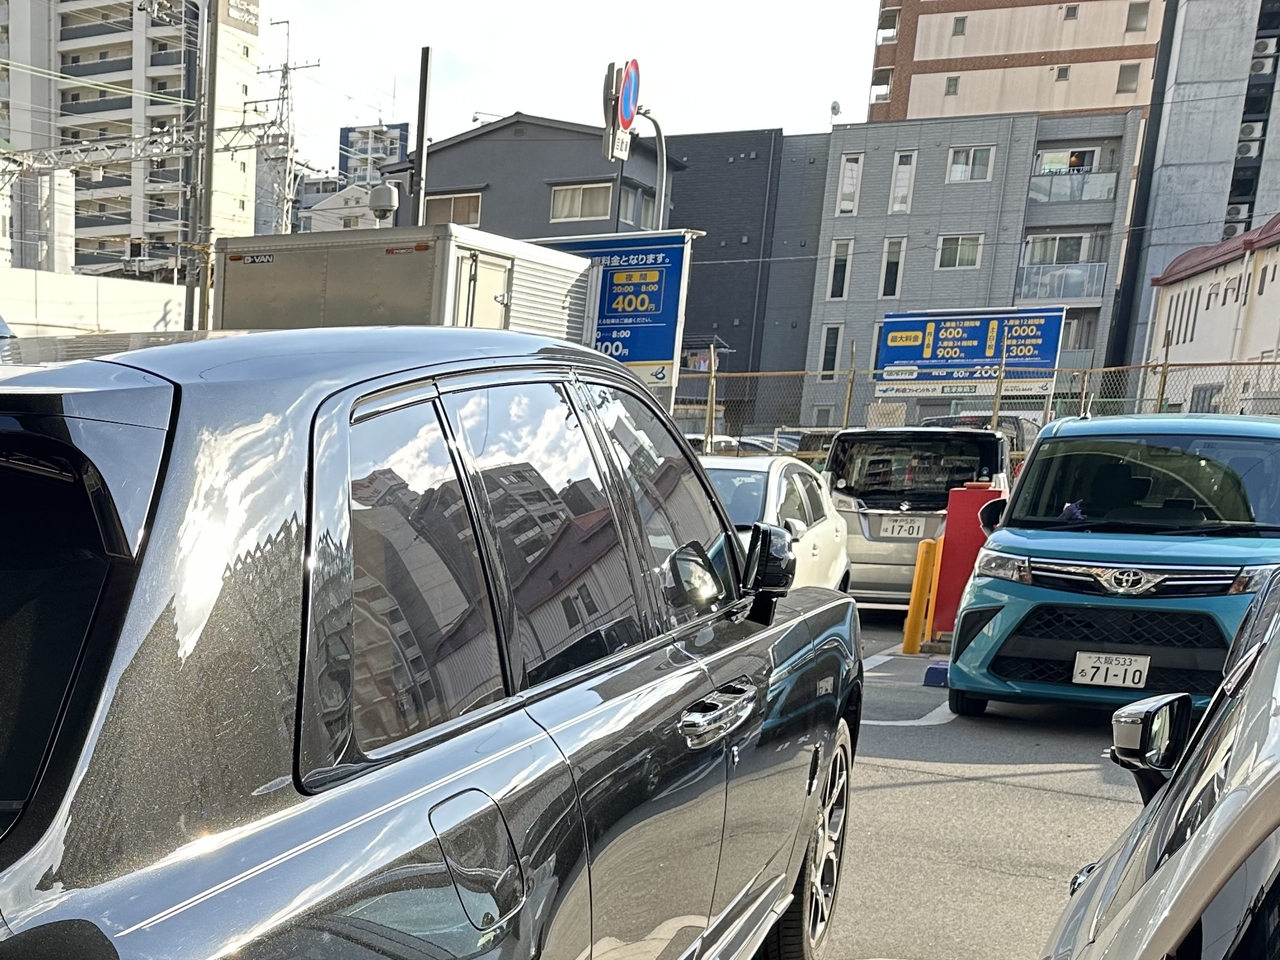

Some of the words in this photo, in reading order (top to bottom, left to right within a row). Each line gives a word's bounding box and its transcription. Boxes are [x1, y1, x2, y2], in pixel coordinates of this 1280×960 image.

[612, 294, 655, 312] 400円
[612, 330, 631, 338] 8:00
[939, 328, 967, 339] 600円
[936, 348, 964, 358] 900円
[891, 525, 920, 536] 17-01
[1093, 655, 1133, 667] 大阪533
[1090, 666, 1143, 685] 71-10
